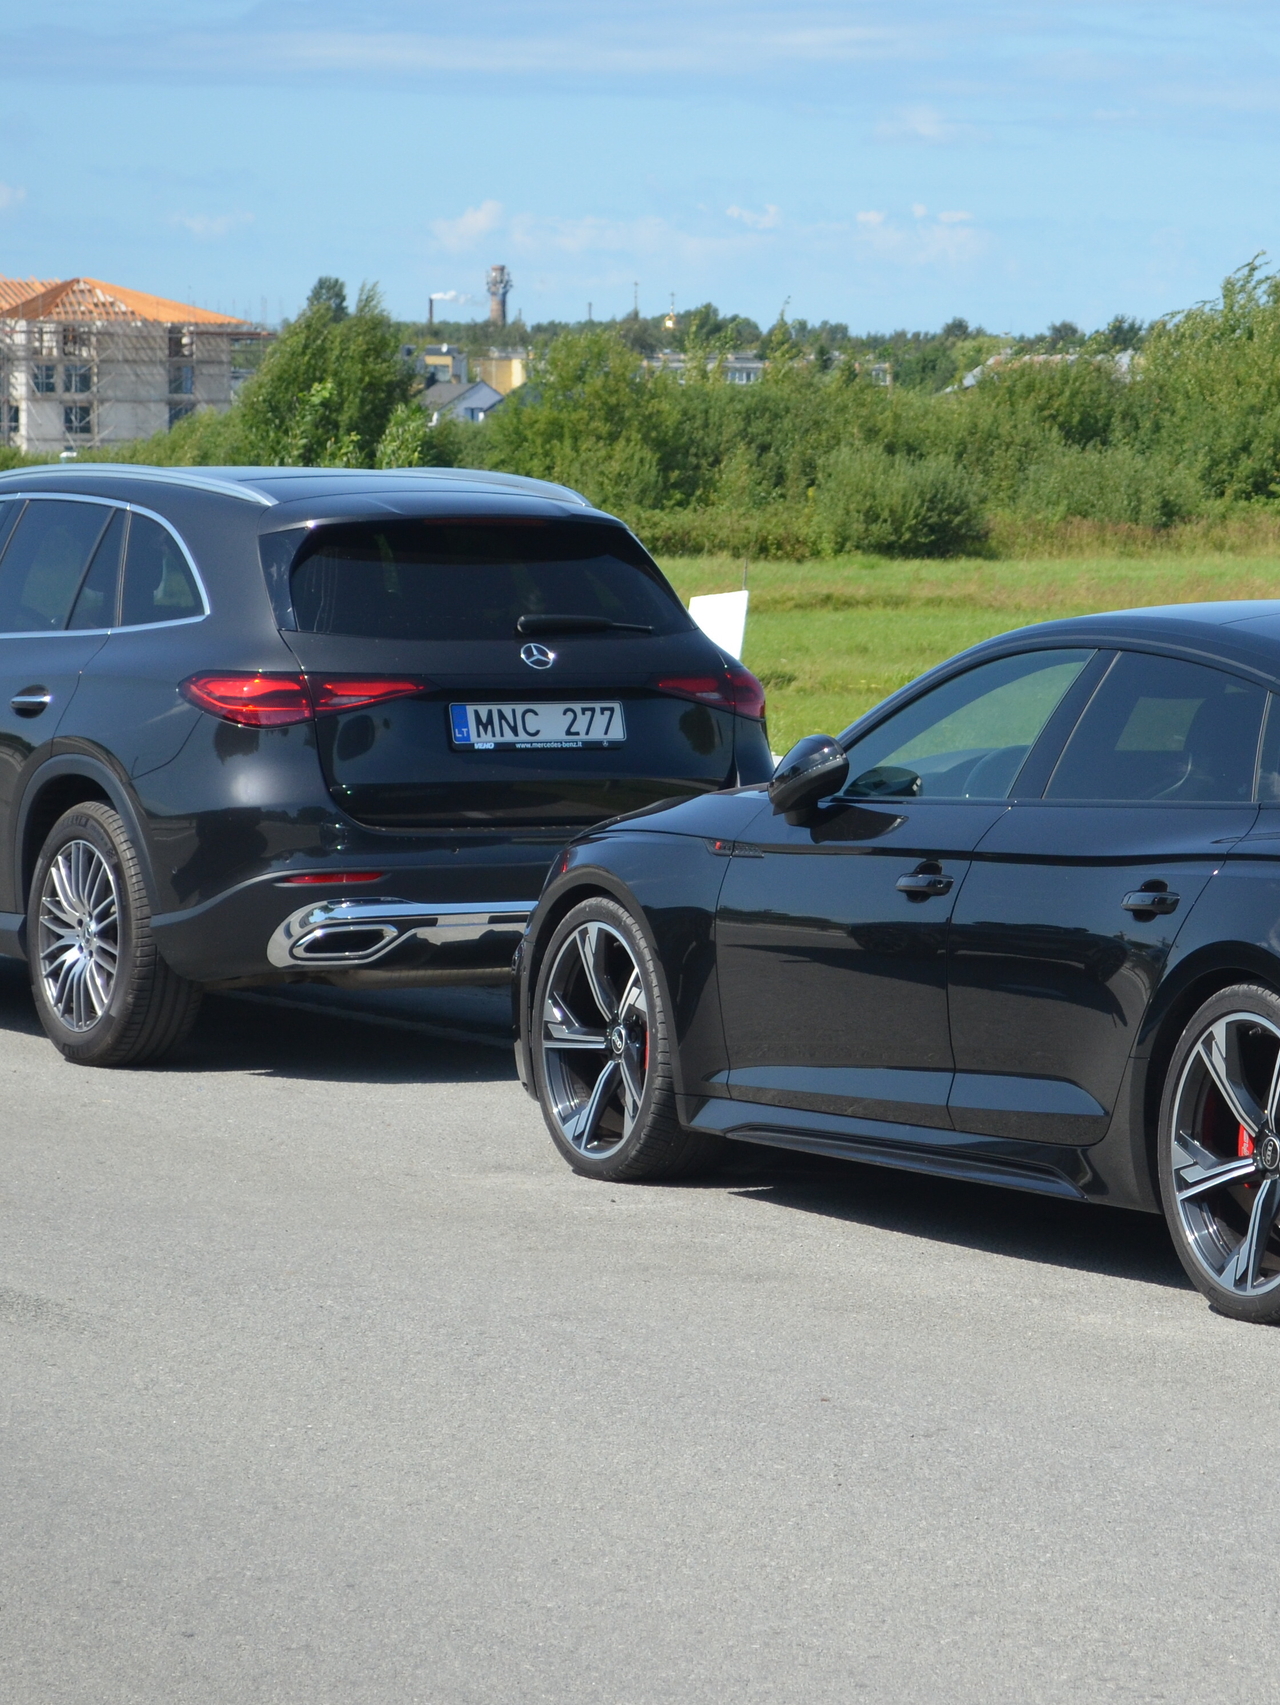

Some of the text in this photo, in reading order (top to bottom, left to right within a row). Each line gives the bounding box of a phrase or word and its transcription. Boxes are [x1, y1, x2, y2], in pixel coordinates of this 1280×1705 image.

[455, 706, 615, 738] LT MNC 277
